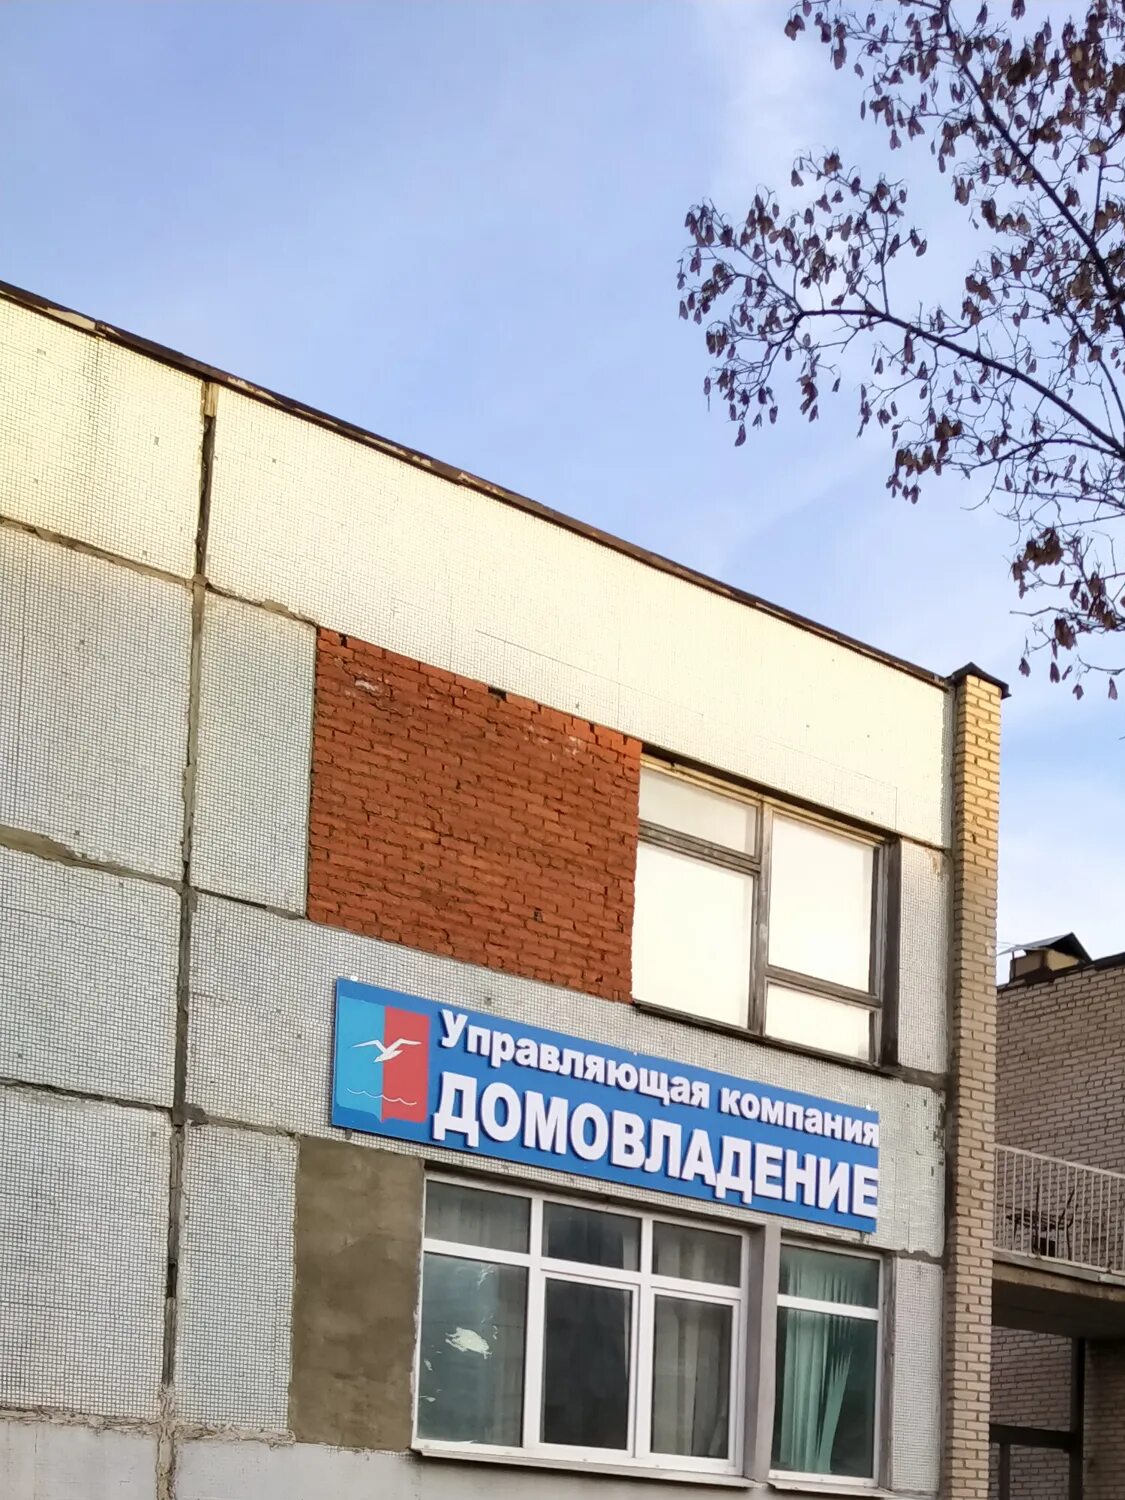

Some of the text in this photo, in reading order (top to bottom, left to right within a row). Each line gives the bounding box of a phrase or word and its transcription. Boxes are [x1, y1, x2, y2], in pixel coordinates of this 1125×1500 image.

[433, 1071, 879, 1217] ДОМОВЛАДЕНИЕ
[439, 1009, 879, 1148] Управляющая компания
